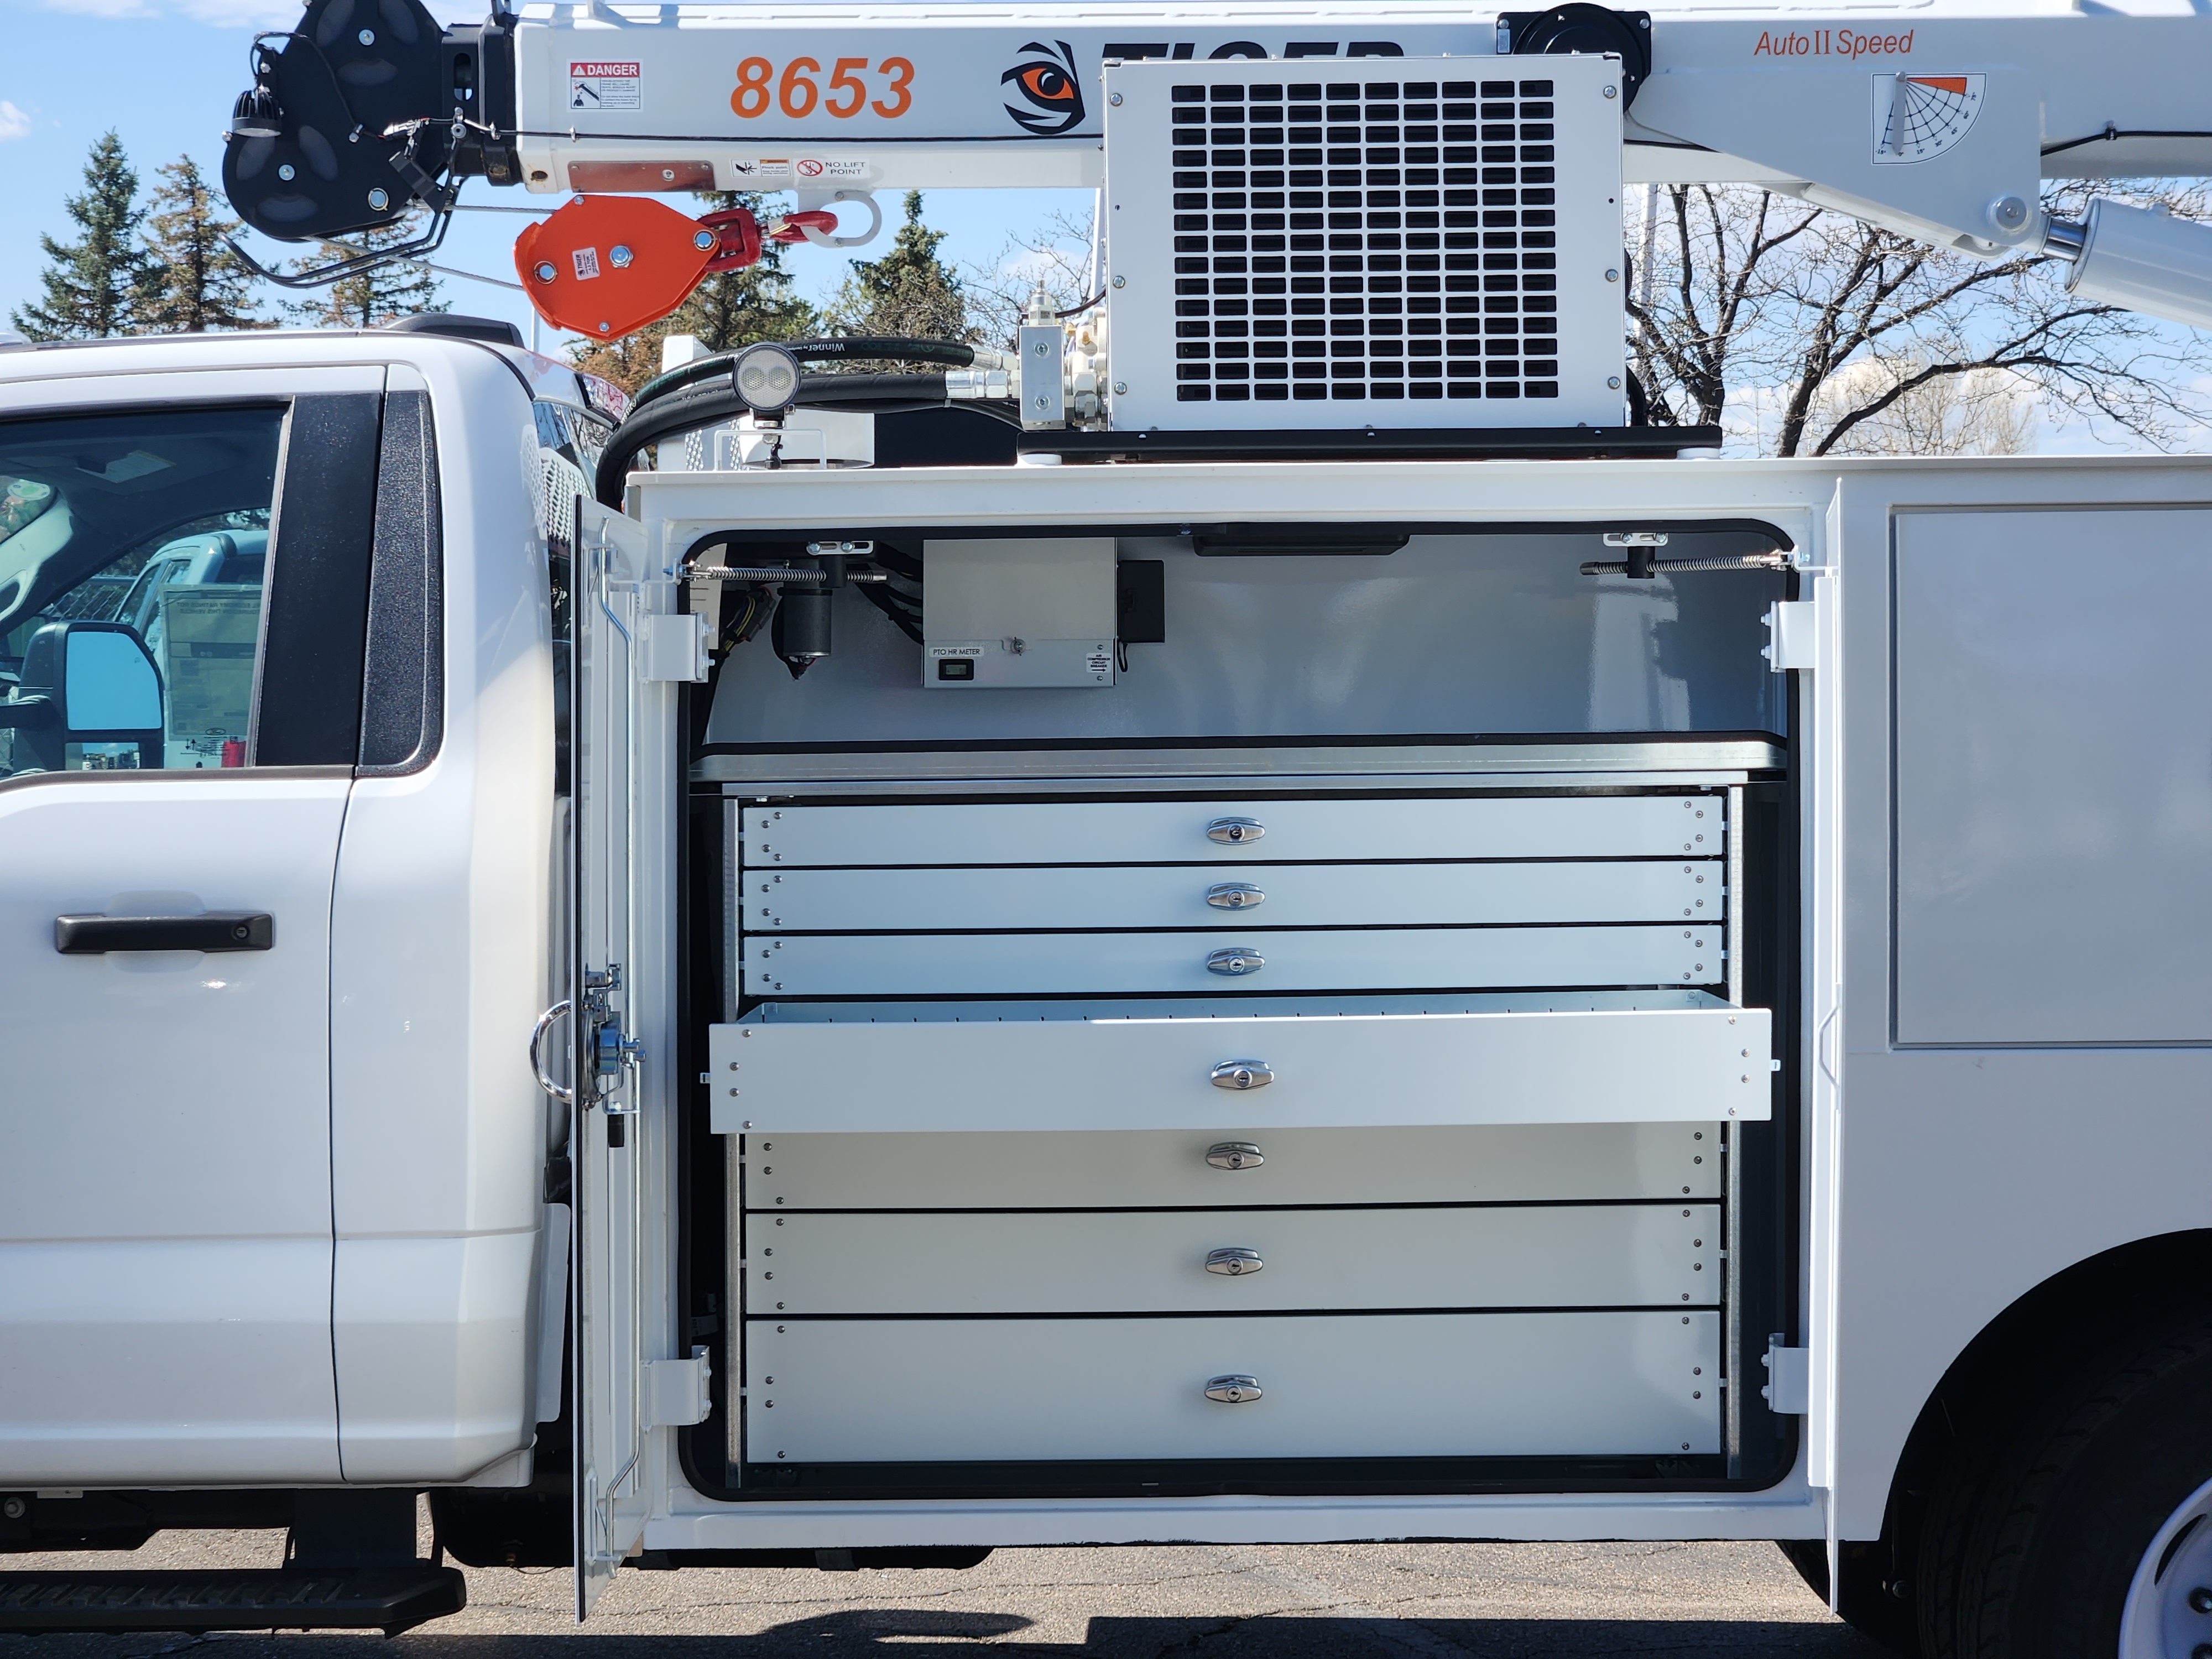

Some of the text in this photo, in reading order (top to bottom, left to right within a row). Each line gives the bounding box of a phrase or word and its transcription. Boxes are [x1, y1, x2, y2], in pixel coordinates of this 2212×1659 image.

[1754, 29, 1914, 60] Auto II Speed
[587, 65, 638, 76] DANGER
[731, 56, 915, 118] 8653
[808, 343, 845, 352] Winner
